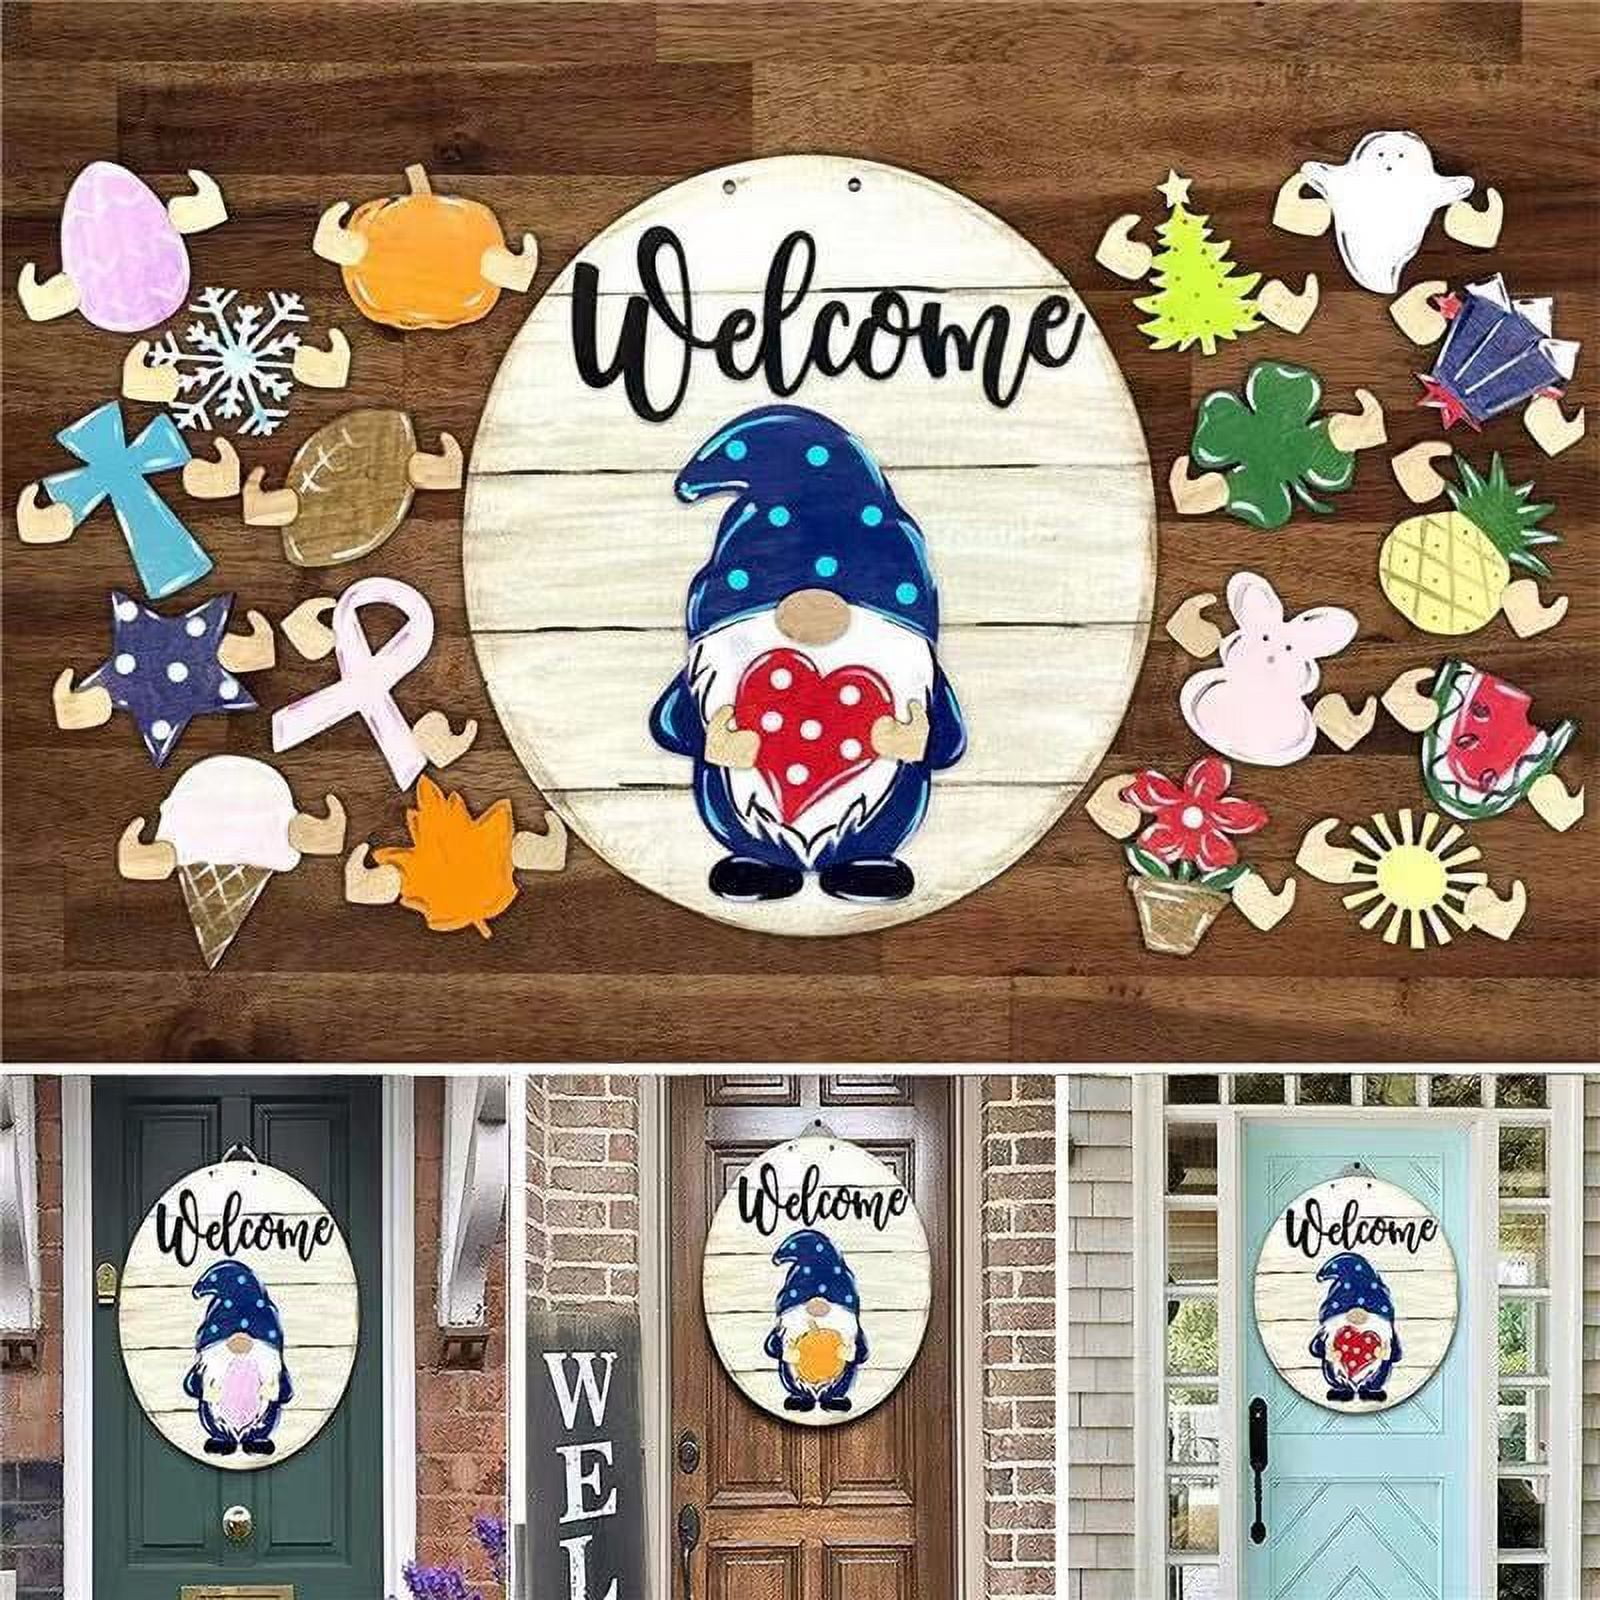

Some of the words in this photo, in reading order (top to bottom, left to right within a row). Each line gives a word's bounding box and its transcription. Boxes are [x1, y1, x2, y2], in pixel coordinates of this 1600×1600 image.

[572, 226, 1085, 422] Welcome
[156, 1189, 334, 1267] Welcome
[738, 1163, 909, 1237] Welcome
[1286, 1199, 1438, 1258] Welcome
